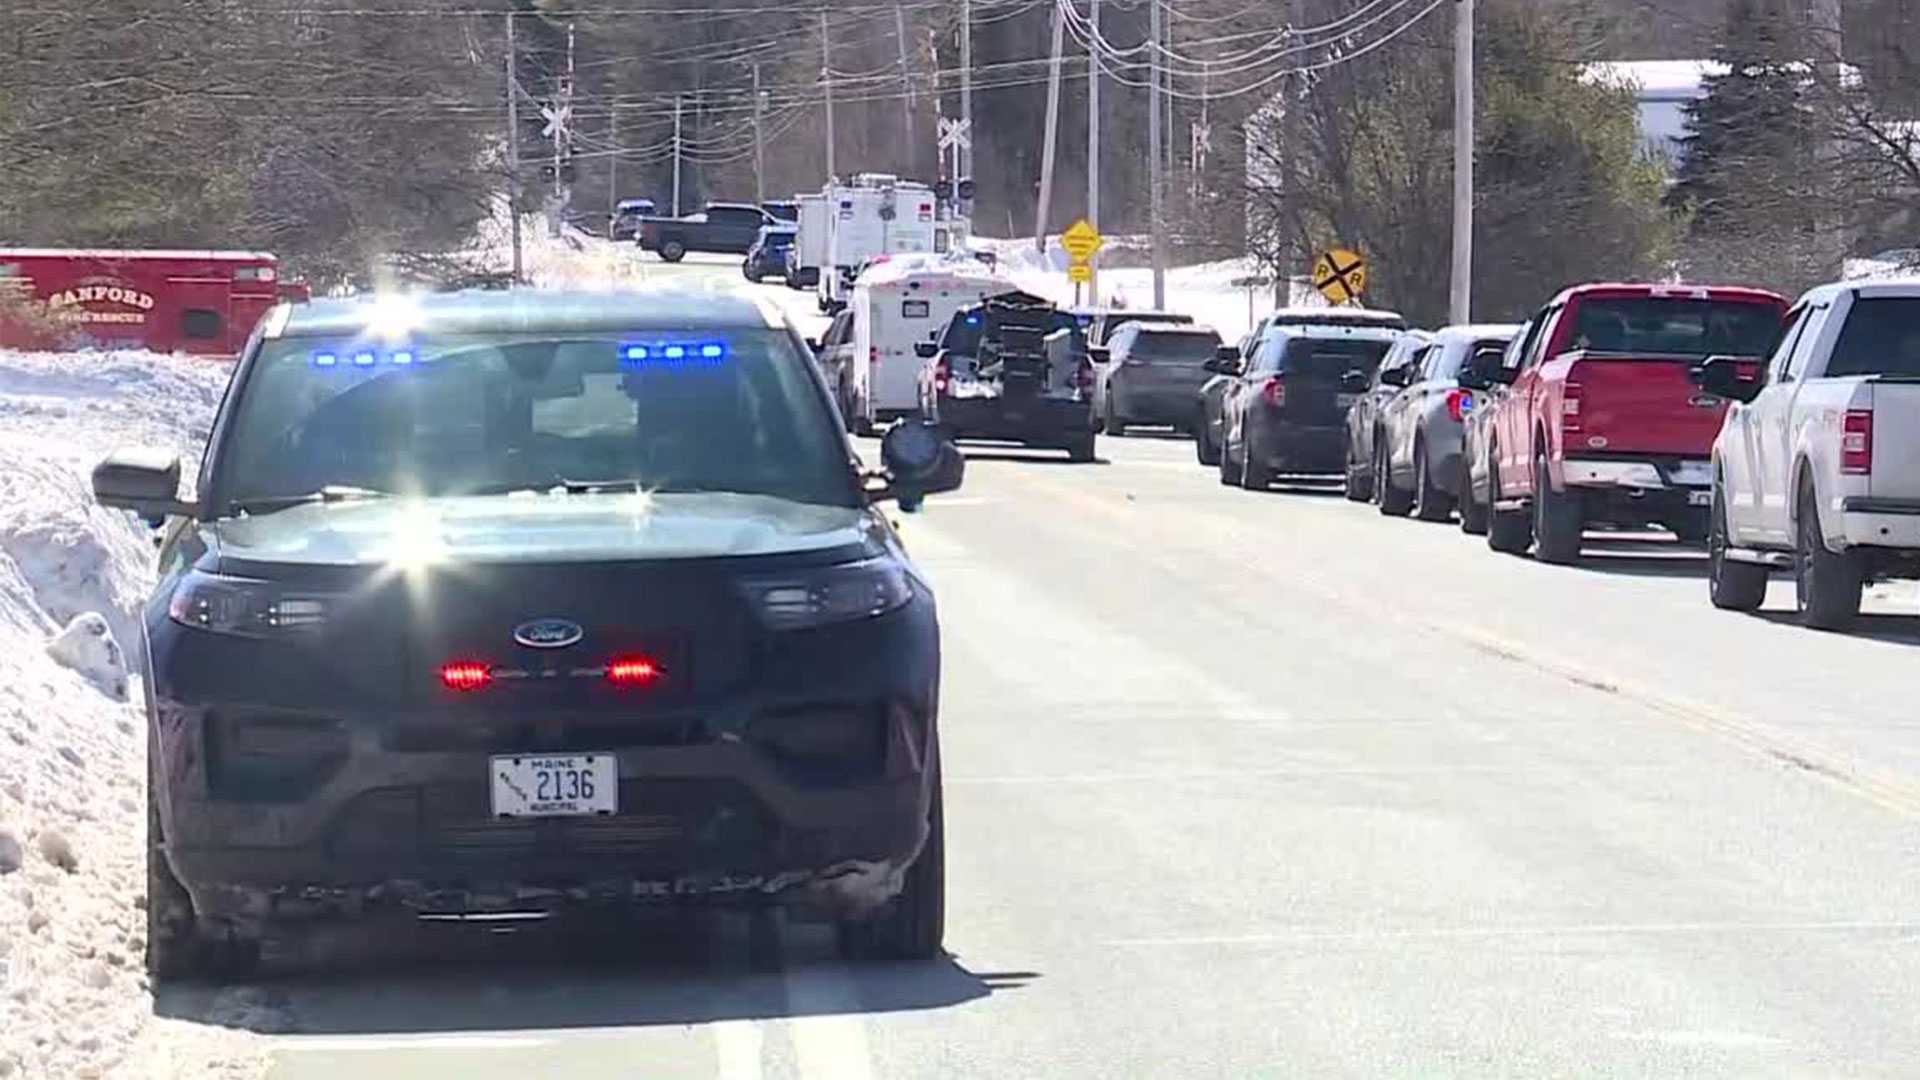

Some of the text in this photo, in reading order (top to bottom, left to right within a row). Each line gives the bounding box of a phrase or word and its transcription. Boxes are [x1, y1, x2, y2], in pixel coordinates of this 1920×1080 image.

[1317, 264, 1362, 286] R R
[50, 286, 154, 309] SANFORD
[531, 759, 575, 769] MAINE
[537, 769, 595, 801] 2136
